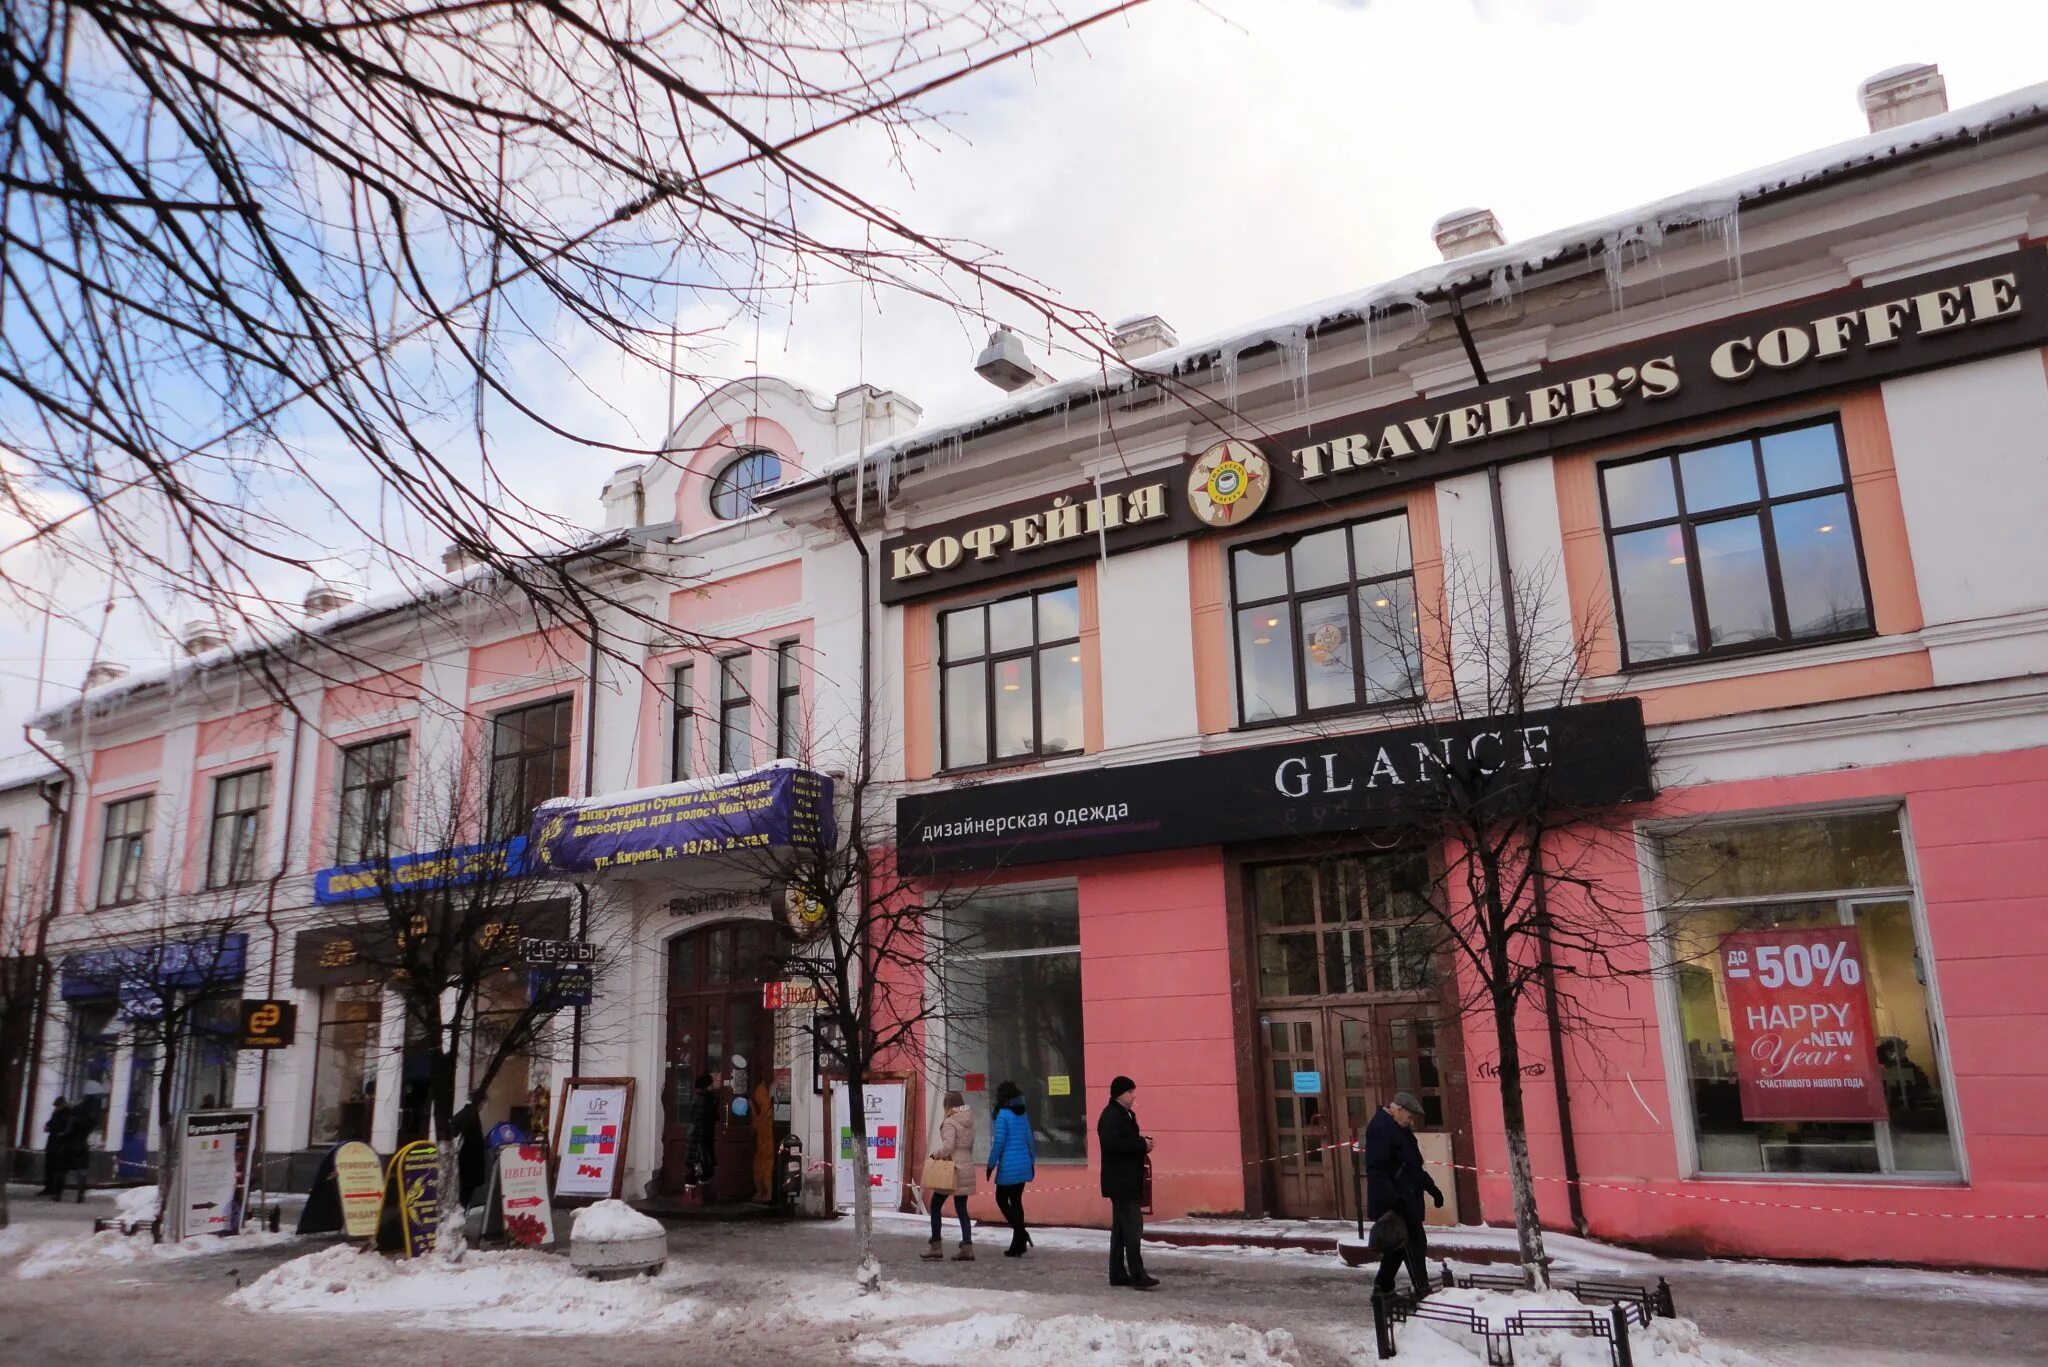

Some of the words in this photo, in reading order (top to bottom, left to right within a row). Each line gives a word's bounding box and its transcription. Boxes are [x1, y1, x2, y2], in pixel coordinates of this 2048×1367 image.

[1293, 355, 1681, 483] TRAVELER'S
[1710, 273, 2022, 381] COFFEE
[891, 484, 1168, 581] КОФЕЙНЯ
[1275, 725, 1552, 798] GLANCE
[579, 803, 646, 821] Бижутерия
[653, 795, 692, 812] Сумки
[573, 817, 647, 837] Аксессуары
[650, 813, 673, 827] для
[676, 807, 709, 821] волос
[922, 811, 1048, 842] дизайнерская
[1054, 803, 1128, 827] одежда
[595, 857, 614, 870] ул.
[617, 848, 662, 865] Кирова,
[665, 846, 677, 859] д.
[1728, 951, 1748, 966] ДО
[1747, 1003, 1849, 1030] HAPPY
[1811, 1031, 1853, 1047] NEW
[1751, 1034, 1838, 1077] Year
[1813, 1079, 1843, 1088] НОВОГО
[1844, 1078, 1864, 1088] ГОДА
[504, 1166, 542, 1179] ЦВЕТЫ
